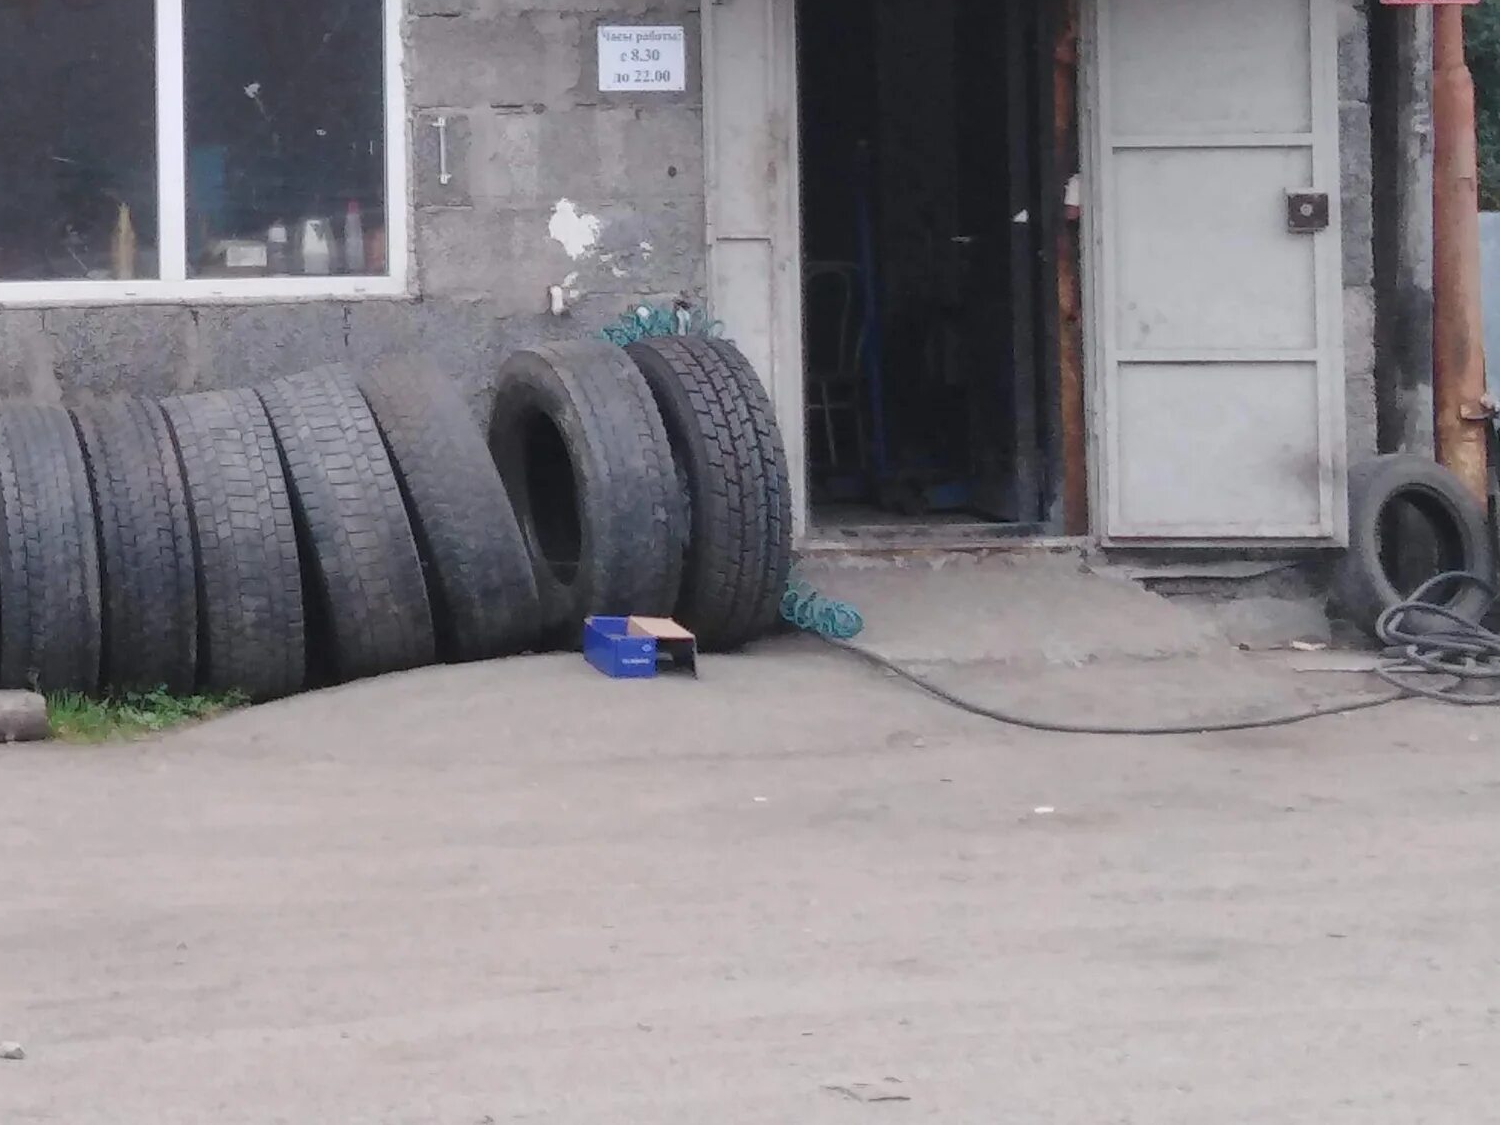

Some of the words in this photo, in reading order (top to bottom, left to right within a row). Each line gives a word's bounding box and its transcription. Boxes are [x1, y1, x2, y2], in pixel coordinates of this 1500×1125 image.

[620, 51, 628, 62] с
[631, 48, 660, 62] 8.30
[634, 70, 670, 83] 22.00
